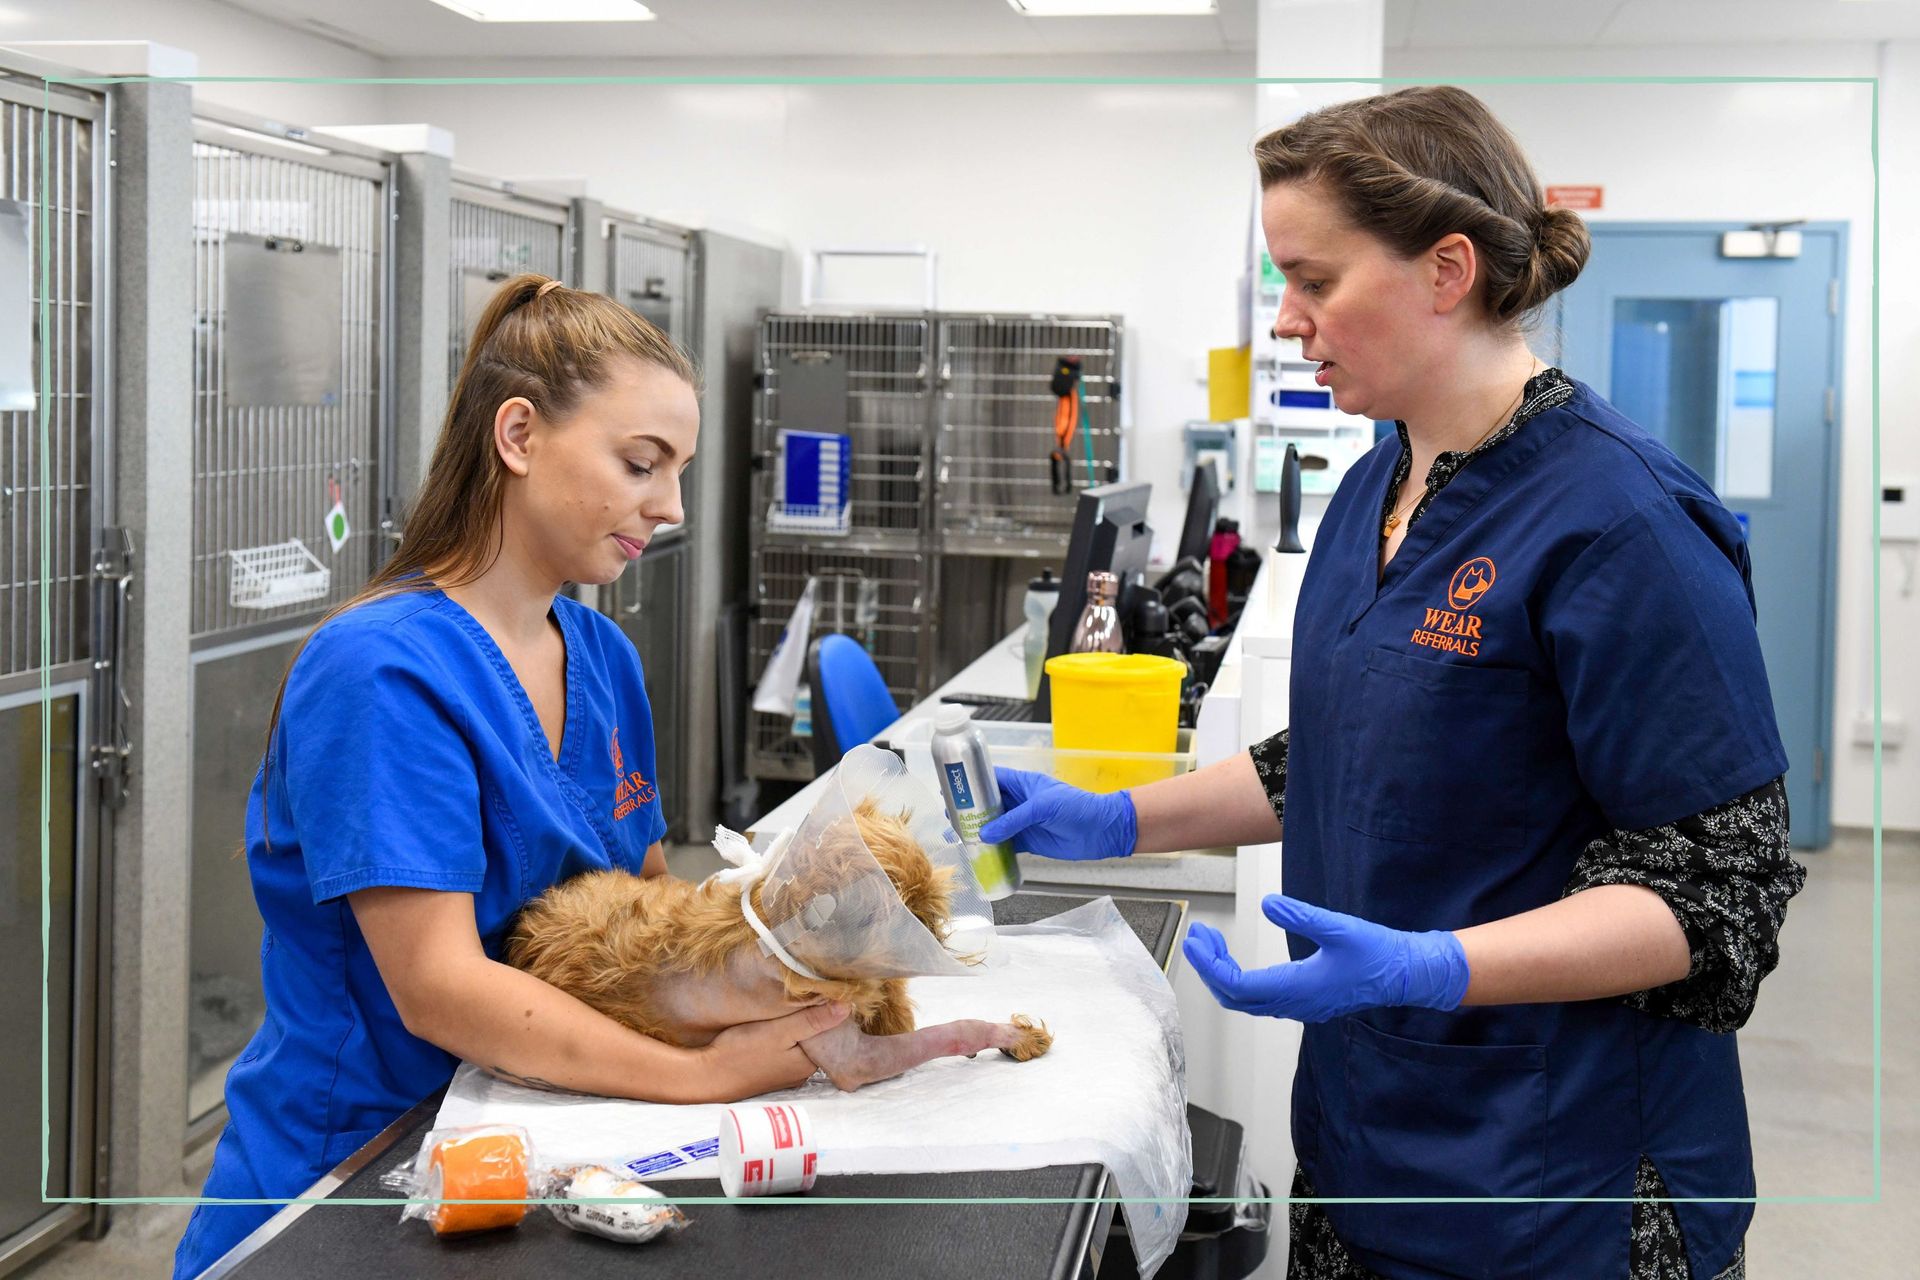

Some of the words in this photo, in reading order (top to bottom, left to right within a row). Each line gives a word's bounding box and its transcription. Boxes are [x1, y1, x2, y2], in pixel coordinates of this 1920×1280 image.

[1423, 607, 1482, 639] WEAR
[1410, 628, 1481, 657] REFERRALS
[951, 769, 965, 794] select
